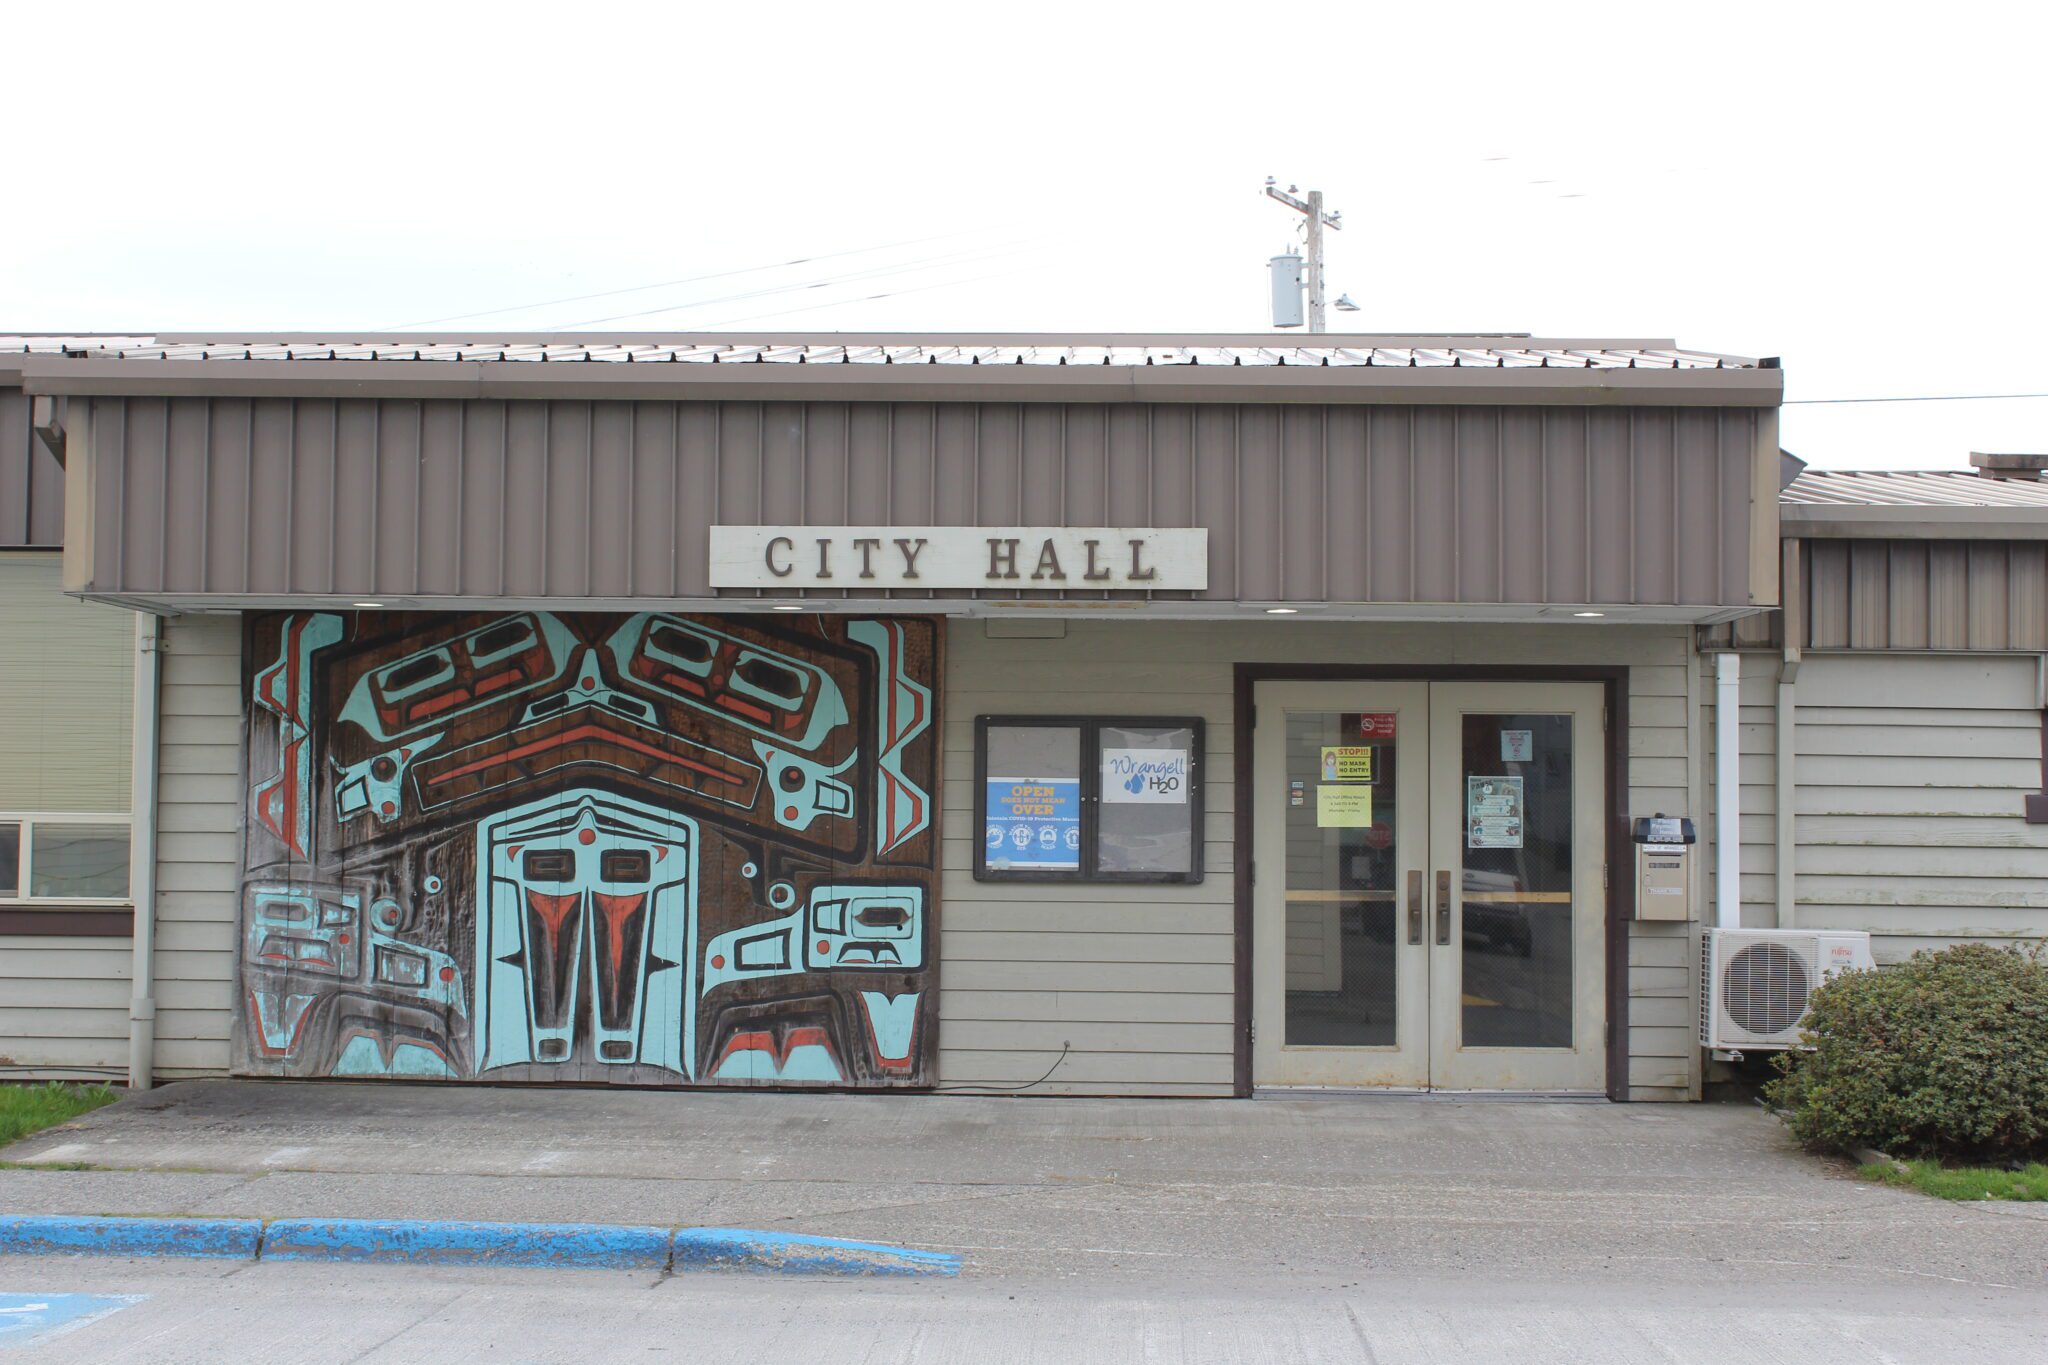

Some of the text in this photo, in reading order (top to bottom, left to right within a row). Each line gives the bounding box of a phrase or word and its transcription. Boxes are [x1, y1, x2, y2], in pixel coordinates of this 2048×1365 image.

[765, 536, 1155, 580] CITY HALL
[1110, 755, 1185, 781] Wrangell
[1012, 785, 1055, 797] OPEN
[1149, 776, 1180, 794] H2O
[1042, 797, 1067, 805] MEAN
[1012, 804, 1054, 815] OVER
